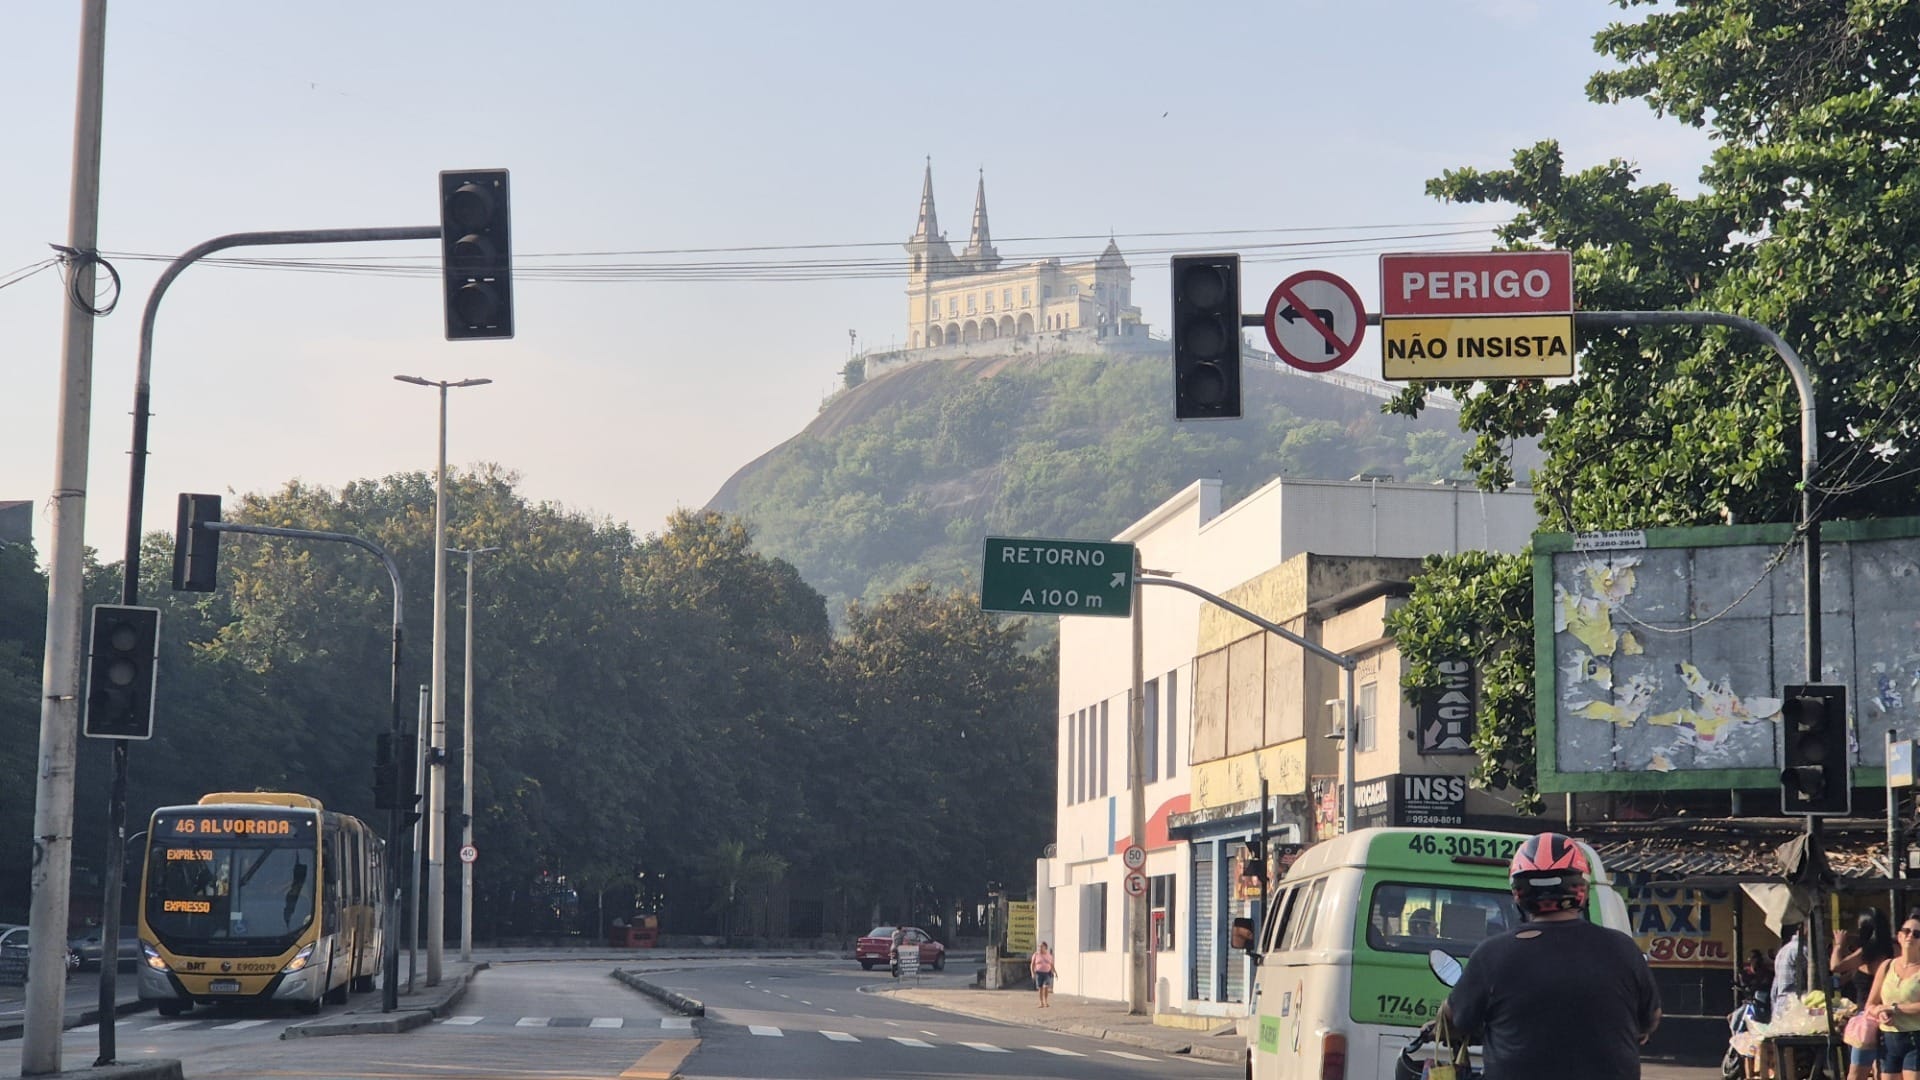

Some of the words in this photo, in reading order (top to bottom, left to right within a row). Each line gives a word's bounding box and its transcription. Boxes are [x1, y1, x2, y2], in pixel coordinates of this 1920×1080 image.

[1402, 269, 1551, 300] PERIGO
[1387, 333, 1448, 360] NÃO
[1456, 335, 1568, 359] INSISTA
[1002, 546, 1105, 566] RETORNO
[1020, 588, 1035, 605] A
[1041, 589, 1079, 607] 100
[1086, 595, 1103, 608] m
[1404, 776, 1465, 802] INSS
[175, 819, 196, 833] 46
[200, 819, 290, 834] ALVORADA
[462, 848, 474, 857] 40
[1128, 850, 1142, 860] 50
[163, 900, 211, 913] EXPRESSO
[1628, 903, 1712, 935] TAXI
[186, 961, 206, 971] BRT
[236, 962, 277, 972] E902079
[1377, 994, 1428, 1016] 1746
